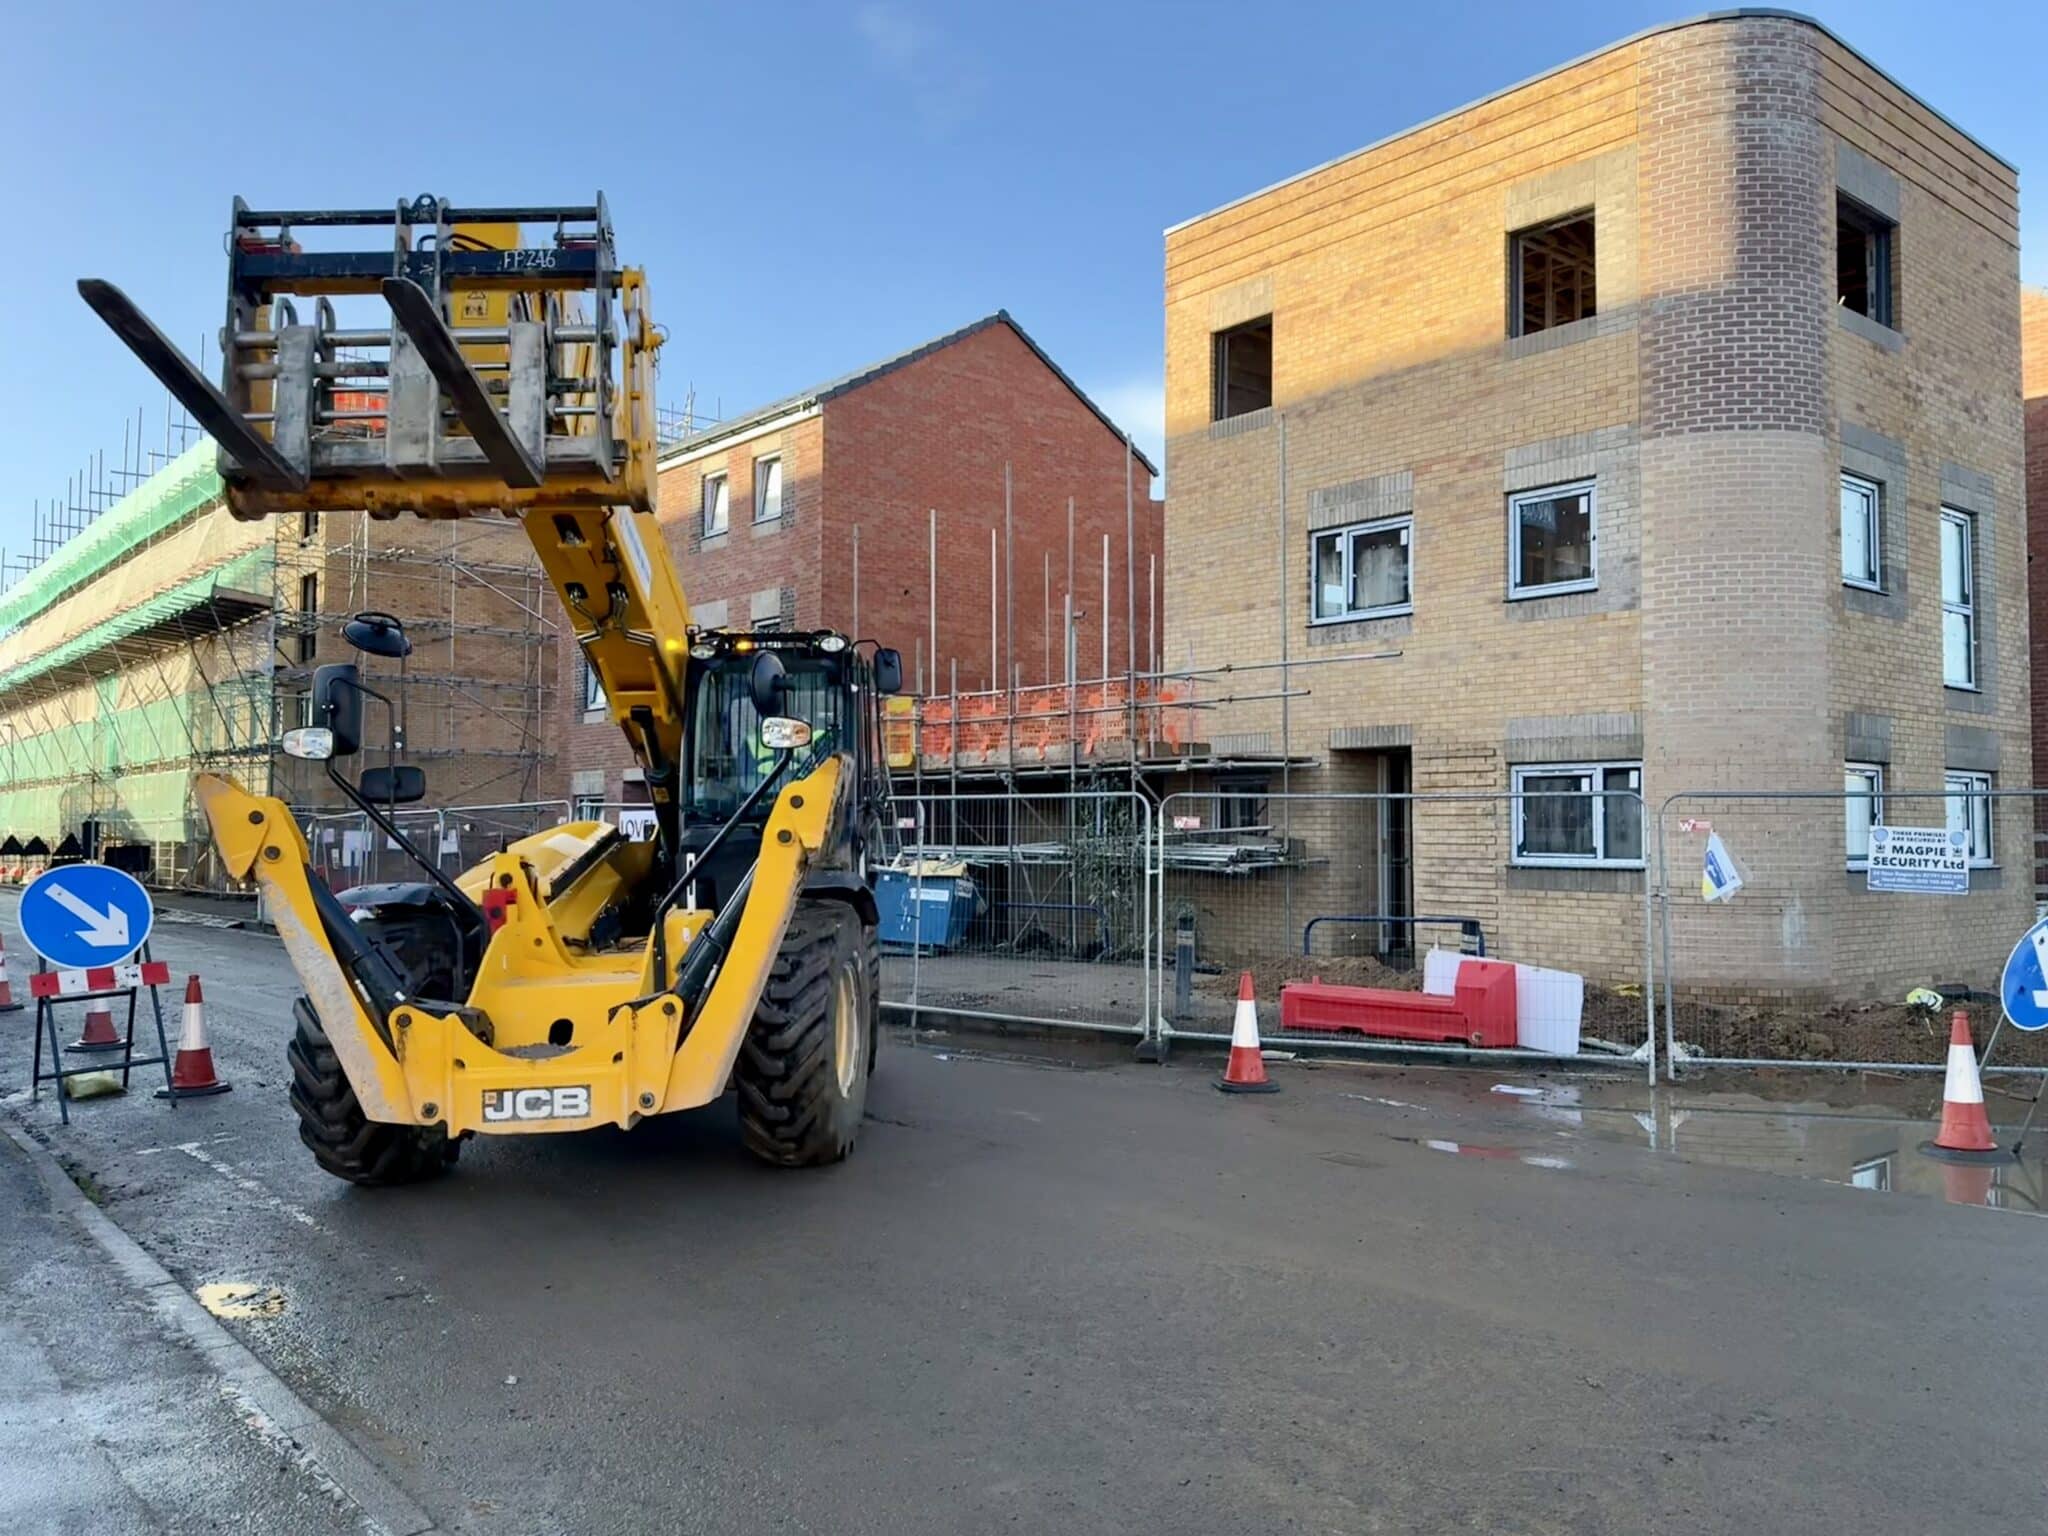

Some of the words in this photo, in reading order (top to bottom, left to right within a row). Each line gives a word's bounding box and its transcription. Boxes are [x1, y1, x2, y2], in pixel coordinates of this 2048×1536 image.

[1892, 845, 1946, 857] MAGPIE
[1873, 856, 1941, 869] SECURITY
[1943, 860, 1965, 870] Ltd
[484, 1087, 589, 1120] JCB
